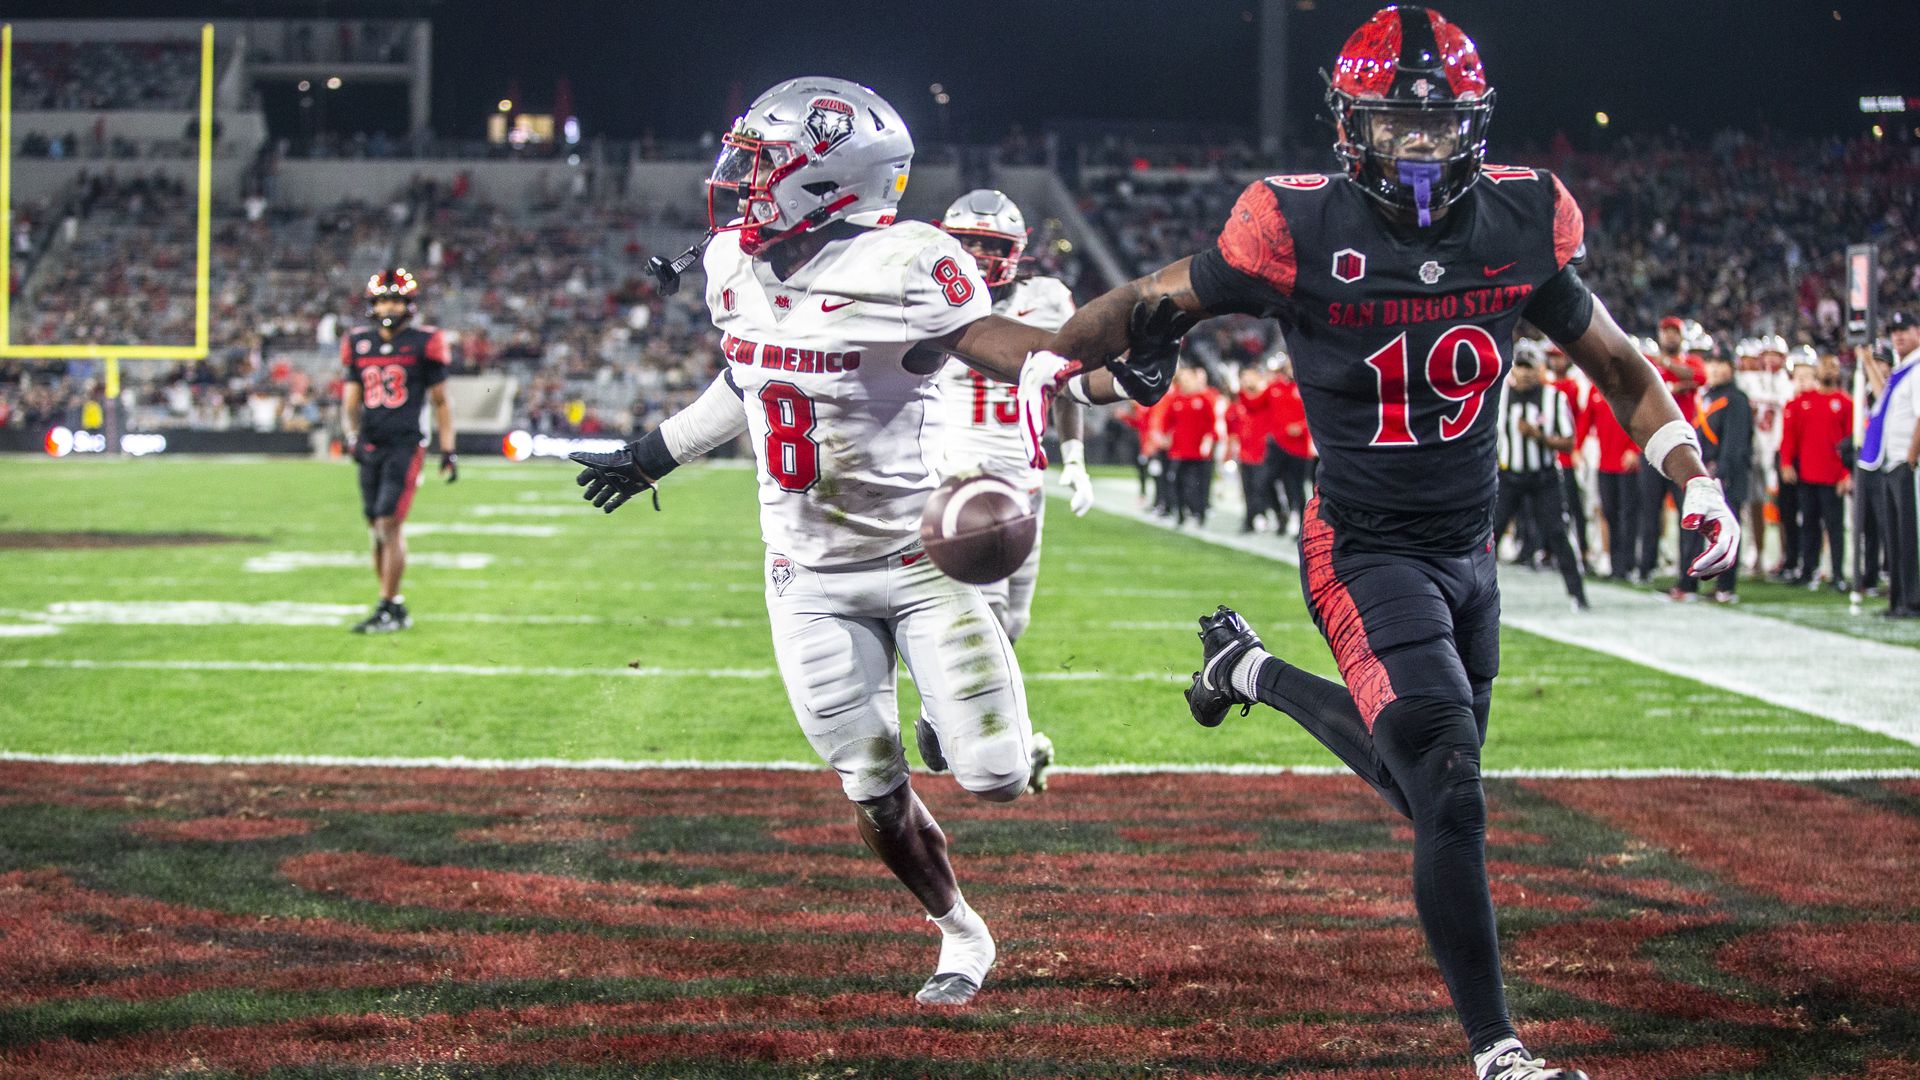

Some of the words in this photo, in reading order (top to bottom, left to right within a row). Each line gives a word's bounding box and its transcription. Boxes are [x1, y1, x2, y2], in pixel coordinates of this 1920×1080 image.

[931, 255, 976, 308] 8
[1328, 302, 1375, 327] SAN
[1383, 295, 1458, 327] DIEGO
[761, 343, 861, 374] MEXICO
[1364, 324, 1502, 446] 19
[758, 379, 821, 494] 8
